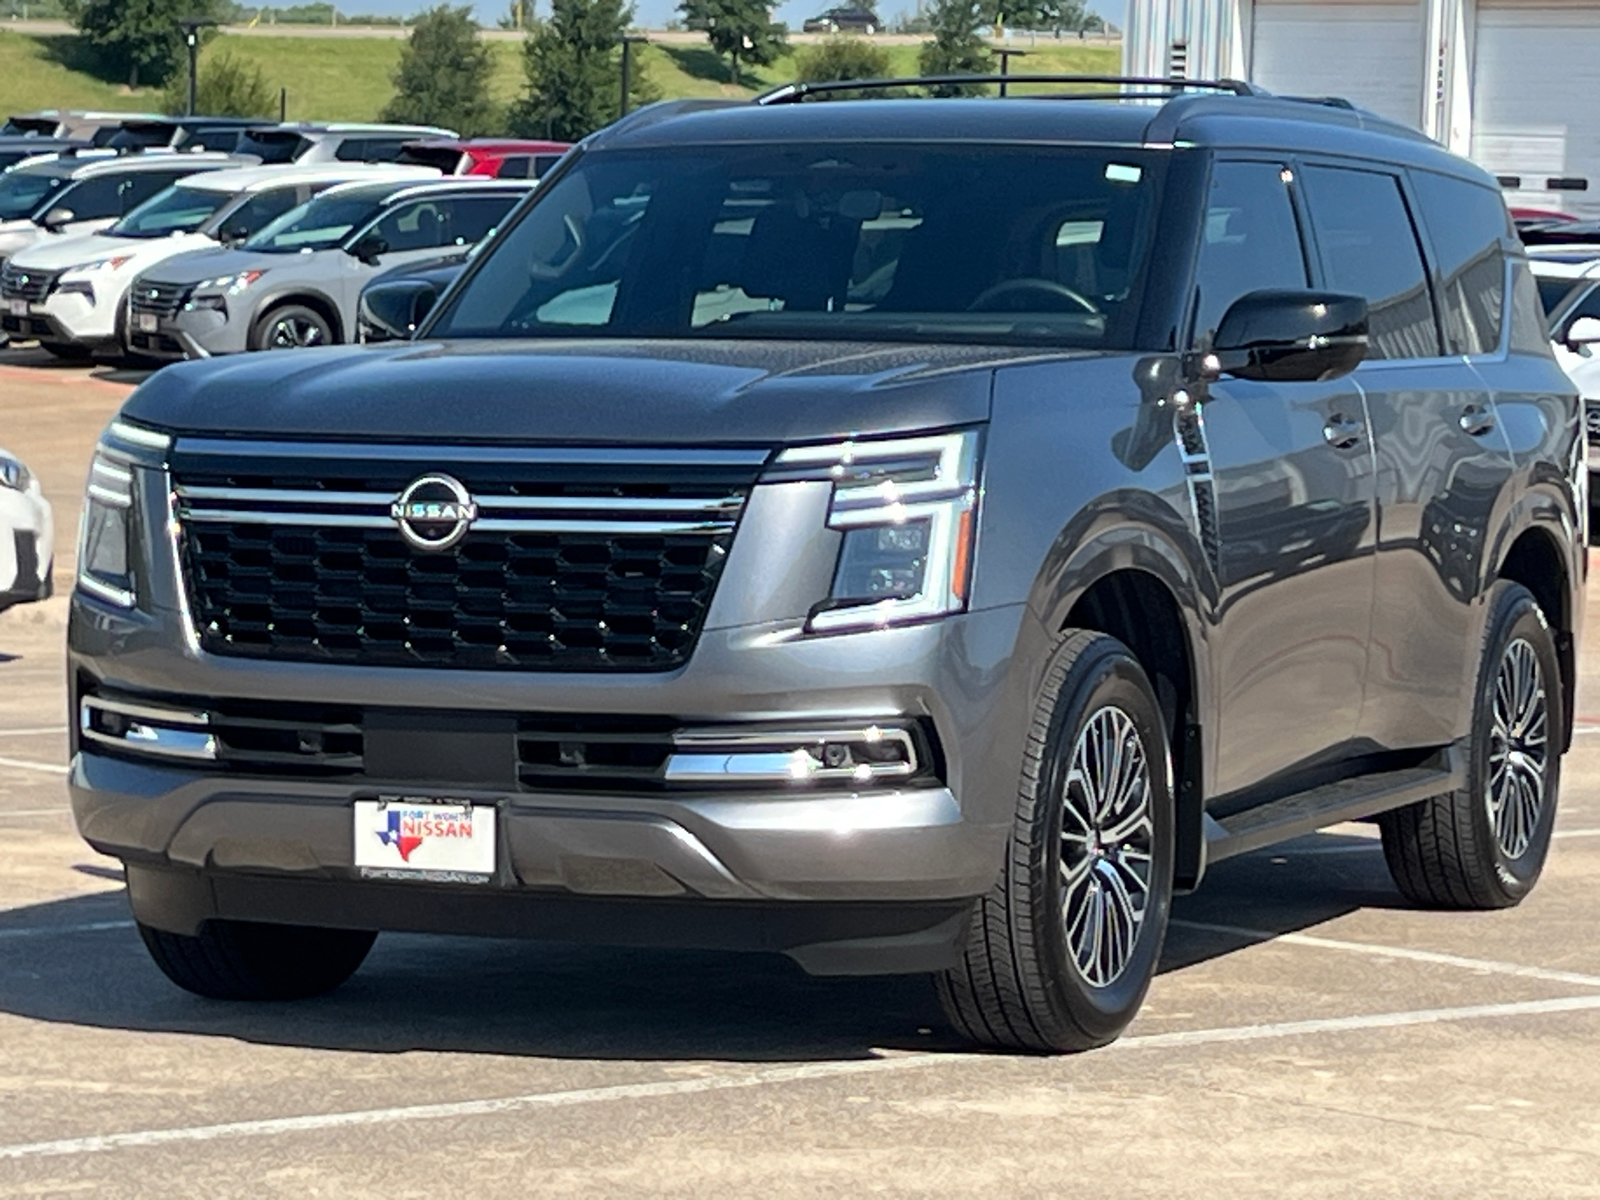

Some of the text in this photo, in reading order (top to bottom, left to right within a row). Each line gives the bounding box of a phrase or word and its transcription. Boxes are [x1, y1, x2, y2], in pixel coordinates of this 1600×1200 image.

[391, 503, 476, 519] NISSAN
[402, 810, 430, 820] FORT
[402, 820, 473, 838] NISSAN
